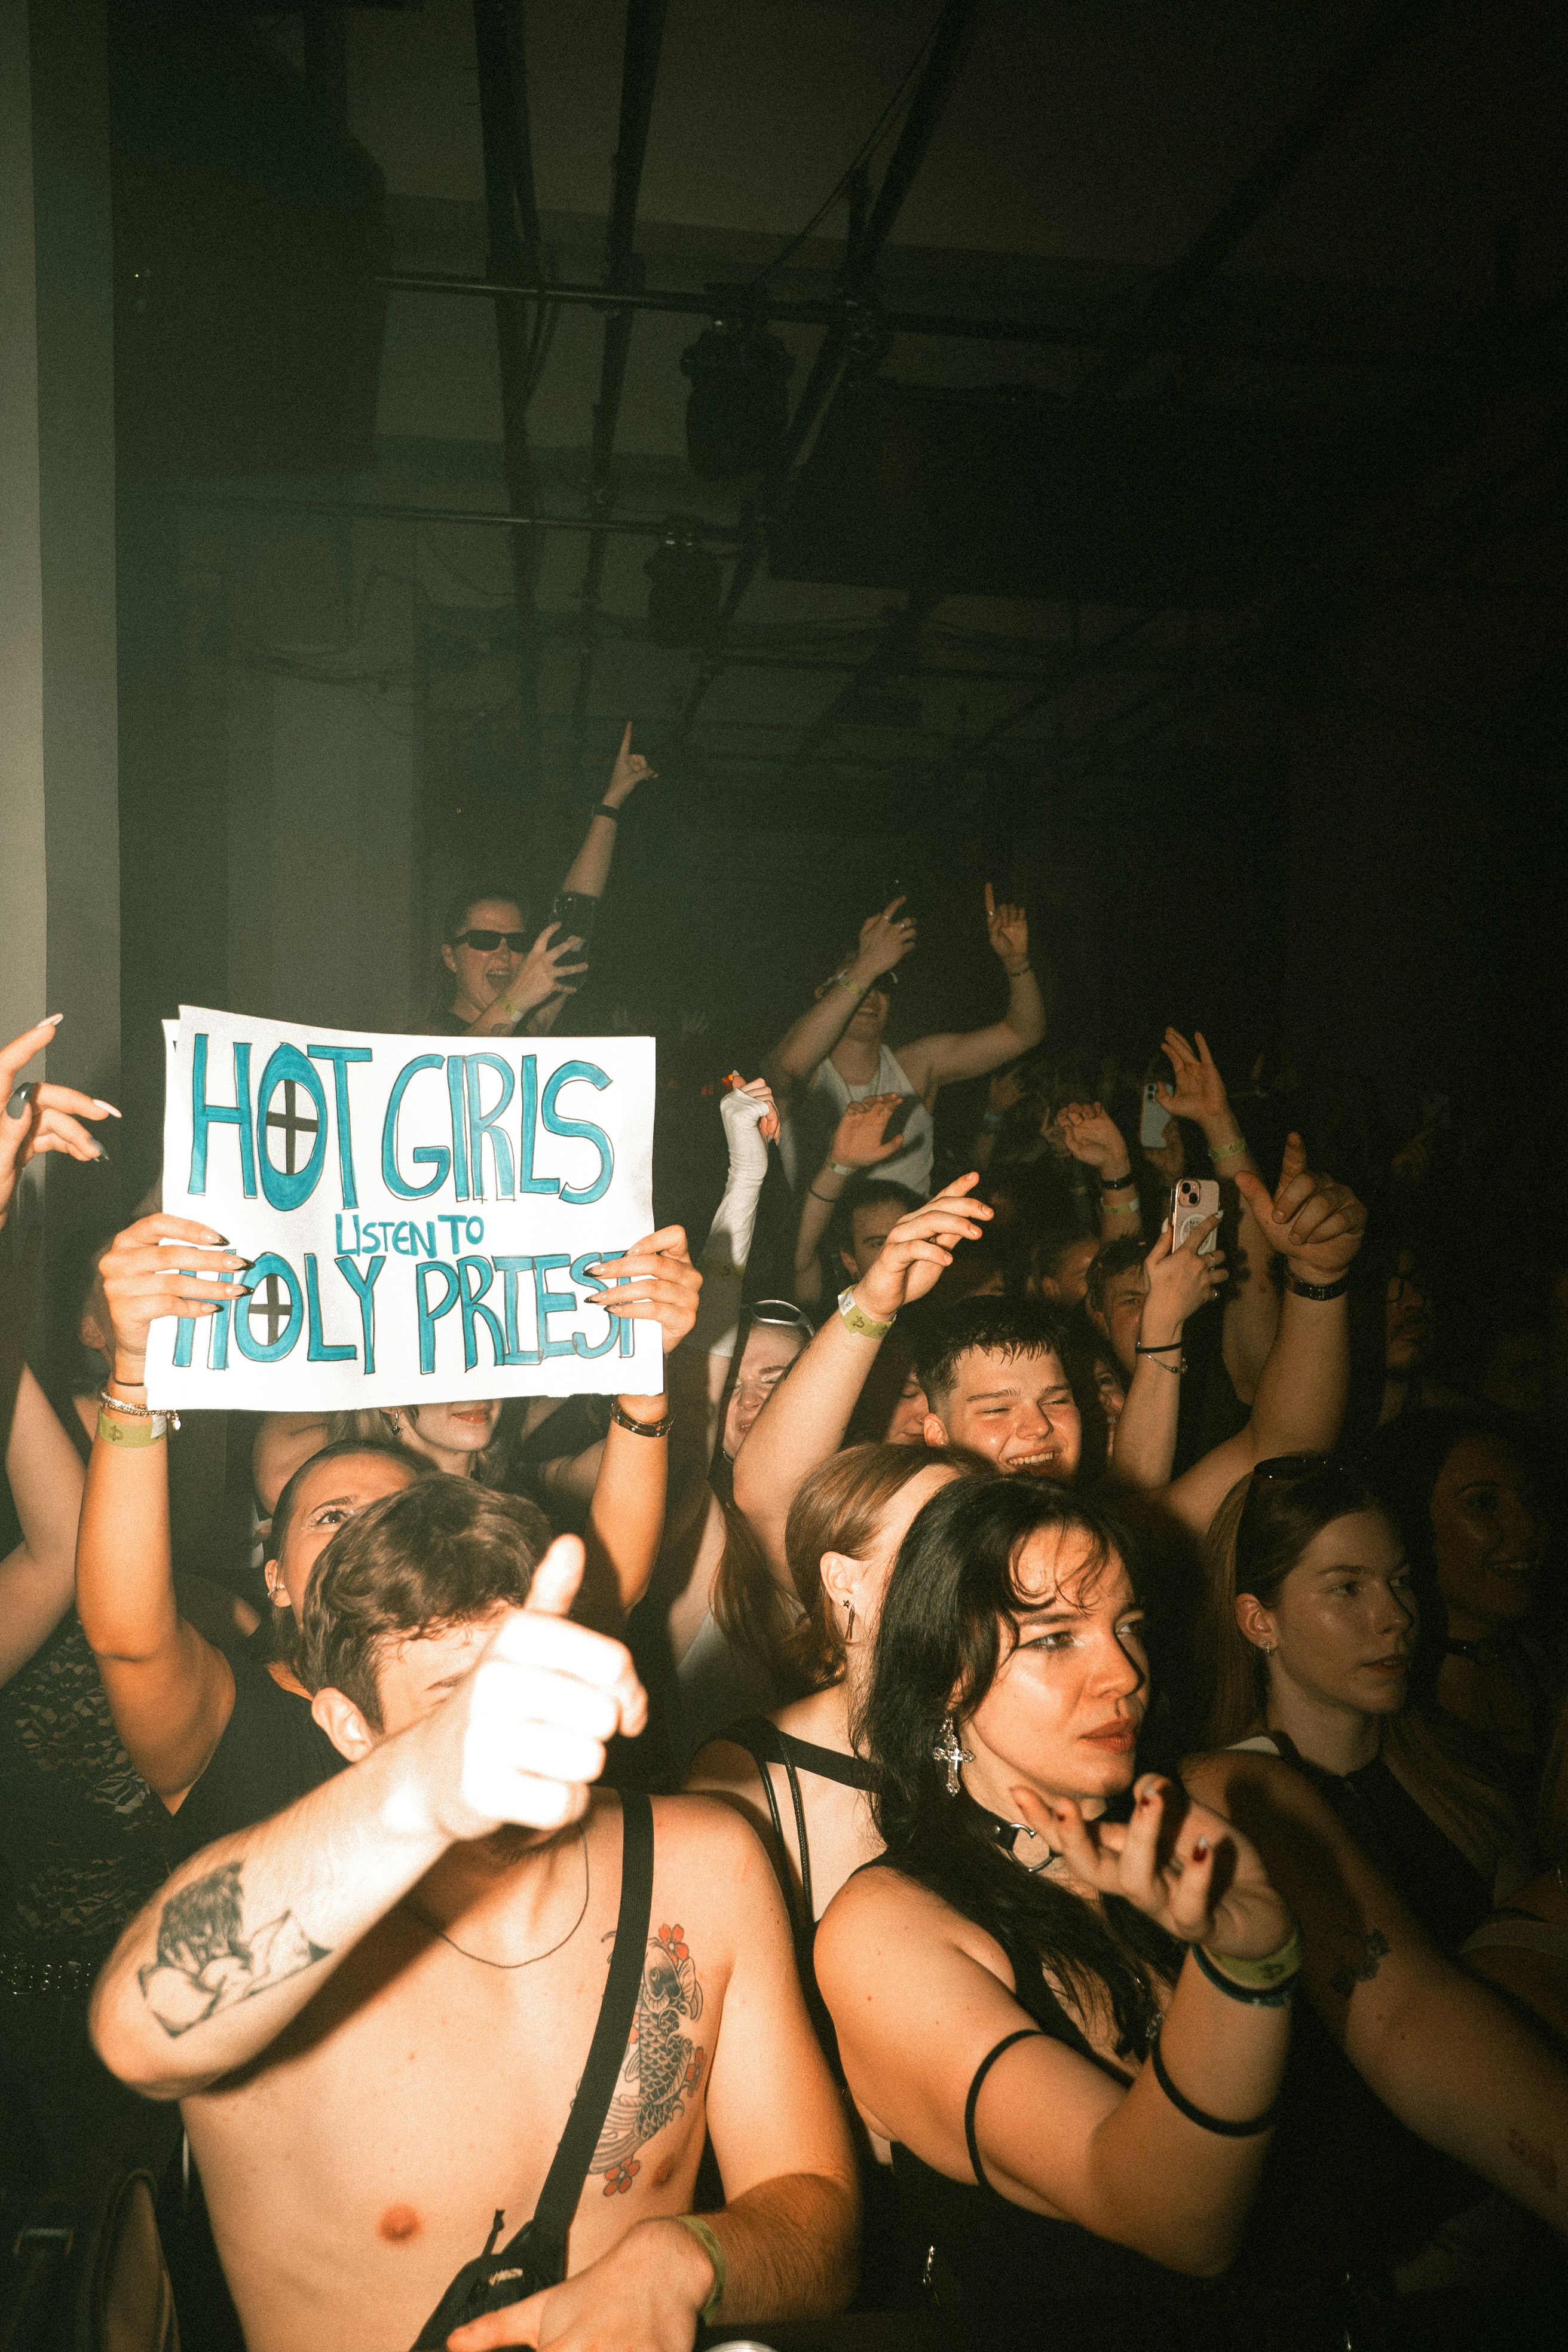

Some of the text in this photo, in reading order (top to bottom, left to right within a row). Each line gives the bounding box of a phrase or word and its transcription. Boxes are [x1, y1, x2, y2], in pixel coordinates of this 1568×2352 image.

[188, 1034, 614, 1211] HOT GIRLS
[335, 1214, 485, 1256] LISTEN TO
